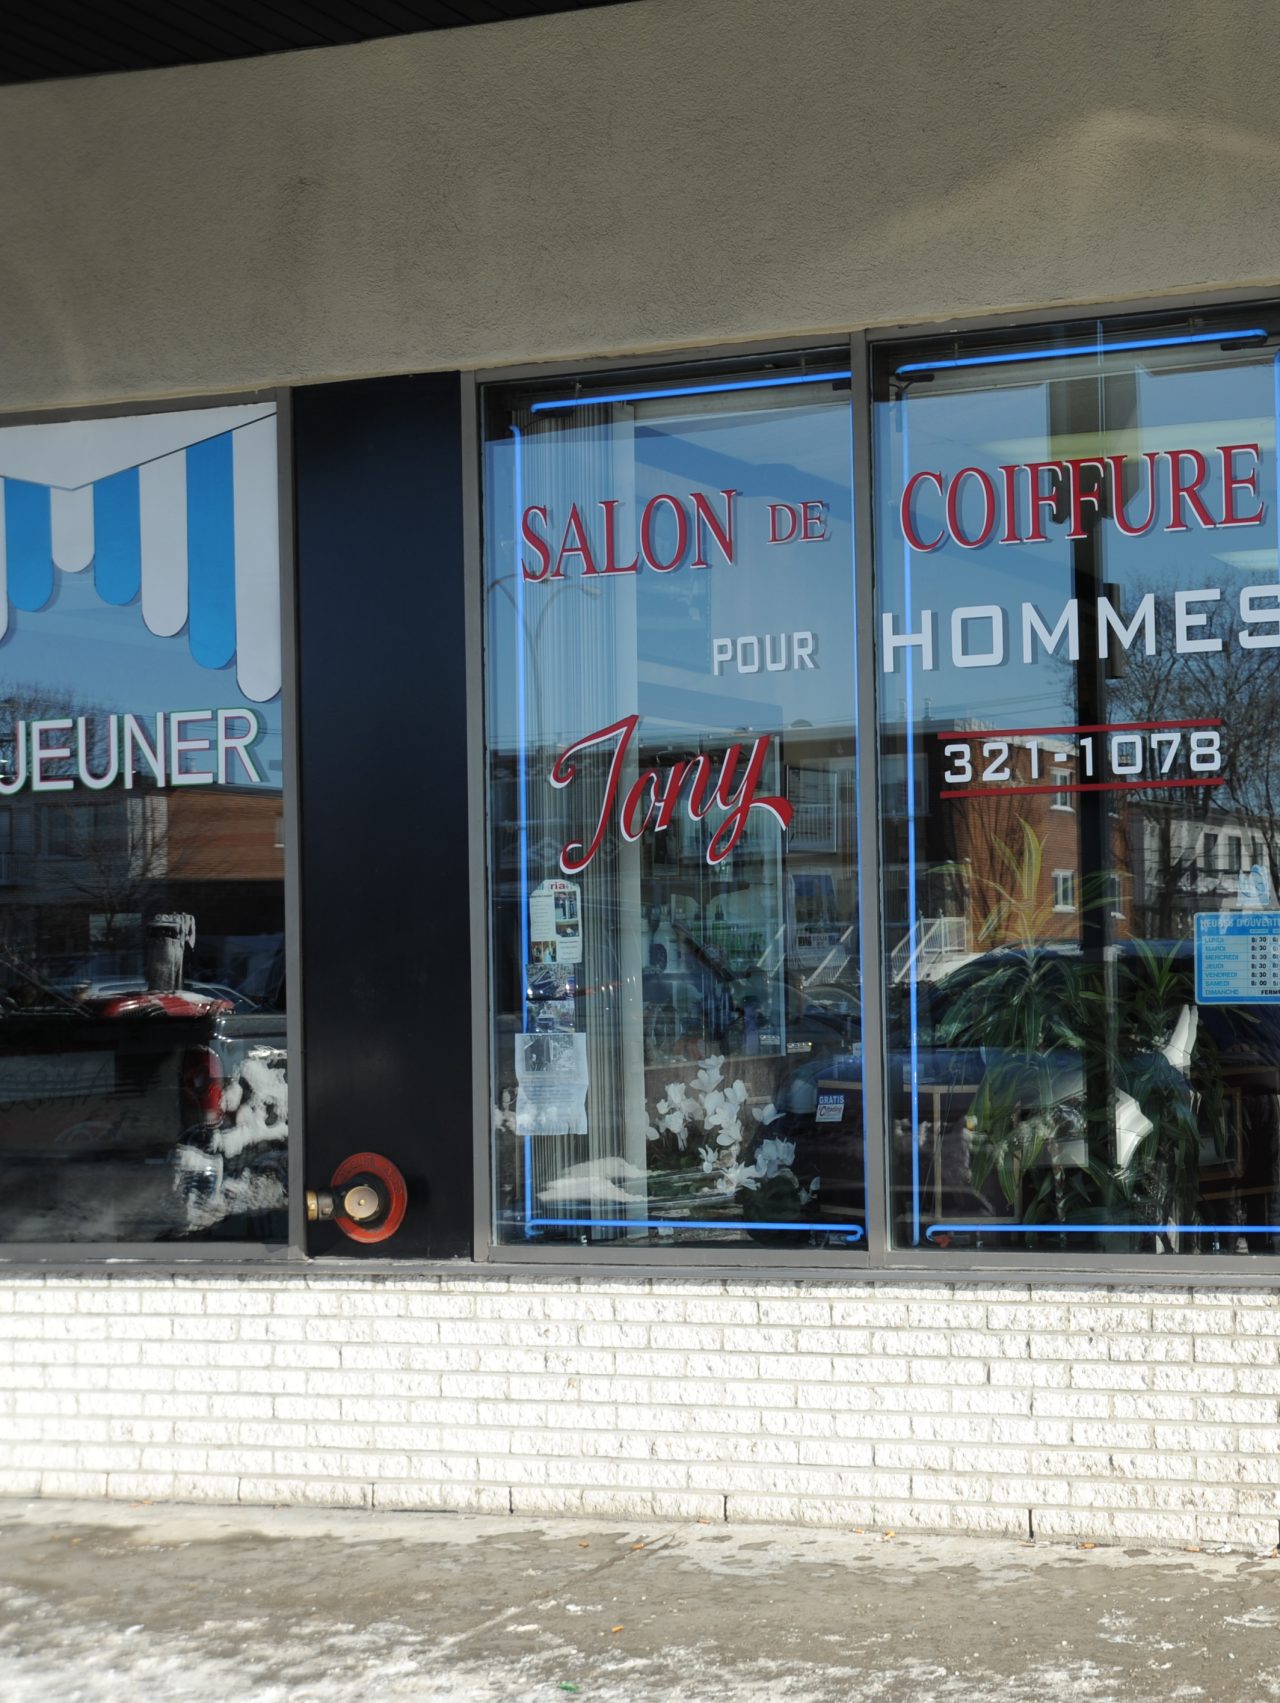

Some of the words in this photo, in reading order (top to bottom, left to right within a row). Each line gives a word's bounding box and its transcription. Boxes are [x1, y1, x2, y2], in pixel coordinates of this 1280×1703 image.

[520, 489, 740, 582] SALON
[766, 500, 828, 544] DE
[900, 443, 1264, 552] COIFFURE
[713, 631, 815, 675] POUR
[0, 706, 263, 795] JEUNER
[944, 731, 1221, 783] 321-1078
[550, 714, 793, 874] Tony
[819, 1095, 845, 1104] GRATIS
